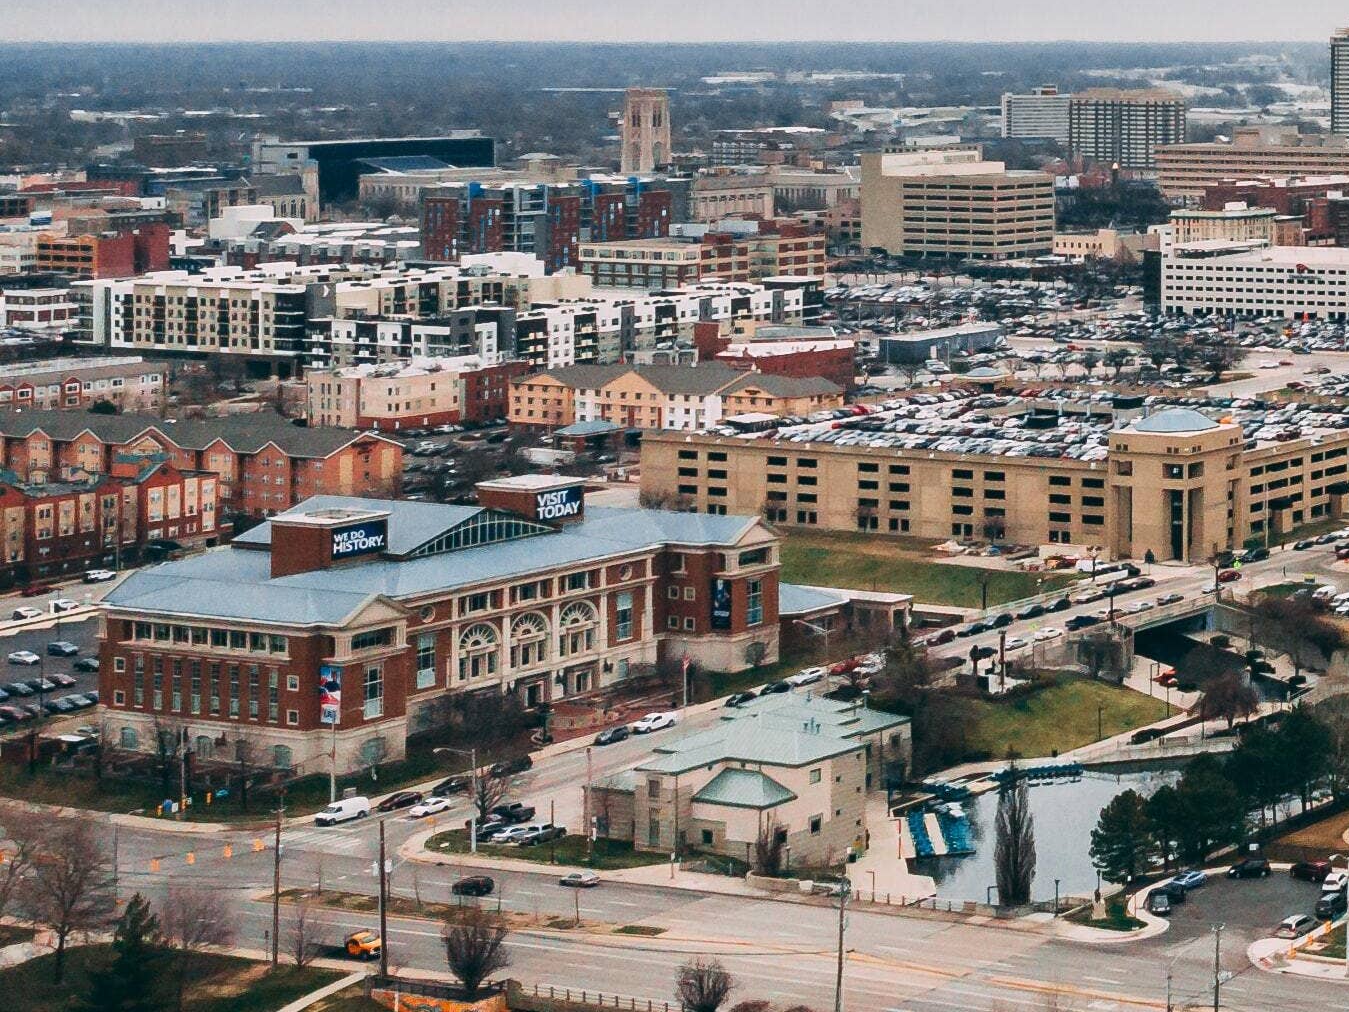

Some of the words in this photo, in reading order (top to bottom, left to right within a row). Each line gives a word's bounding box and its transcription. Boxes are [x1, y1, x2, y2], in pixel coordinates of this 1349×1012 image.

[537, 490, 568, 507] VISIT
[537, 500, 580, 520] TODAY
[333, 532, 349, 543] WE
[350, 529, 365, 540] DO
[333, 535, 384, 554] HISTORY.
